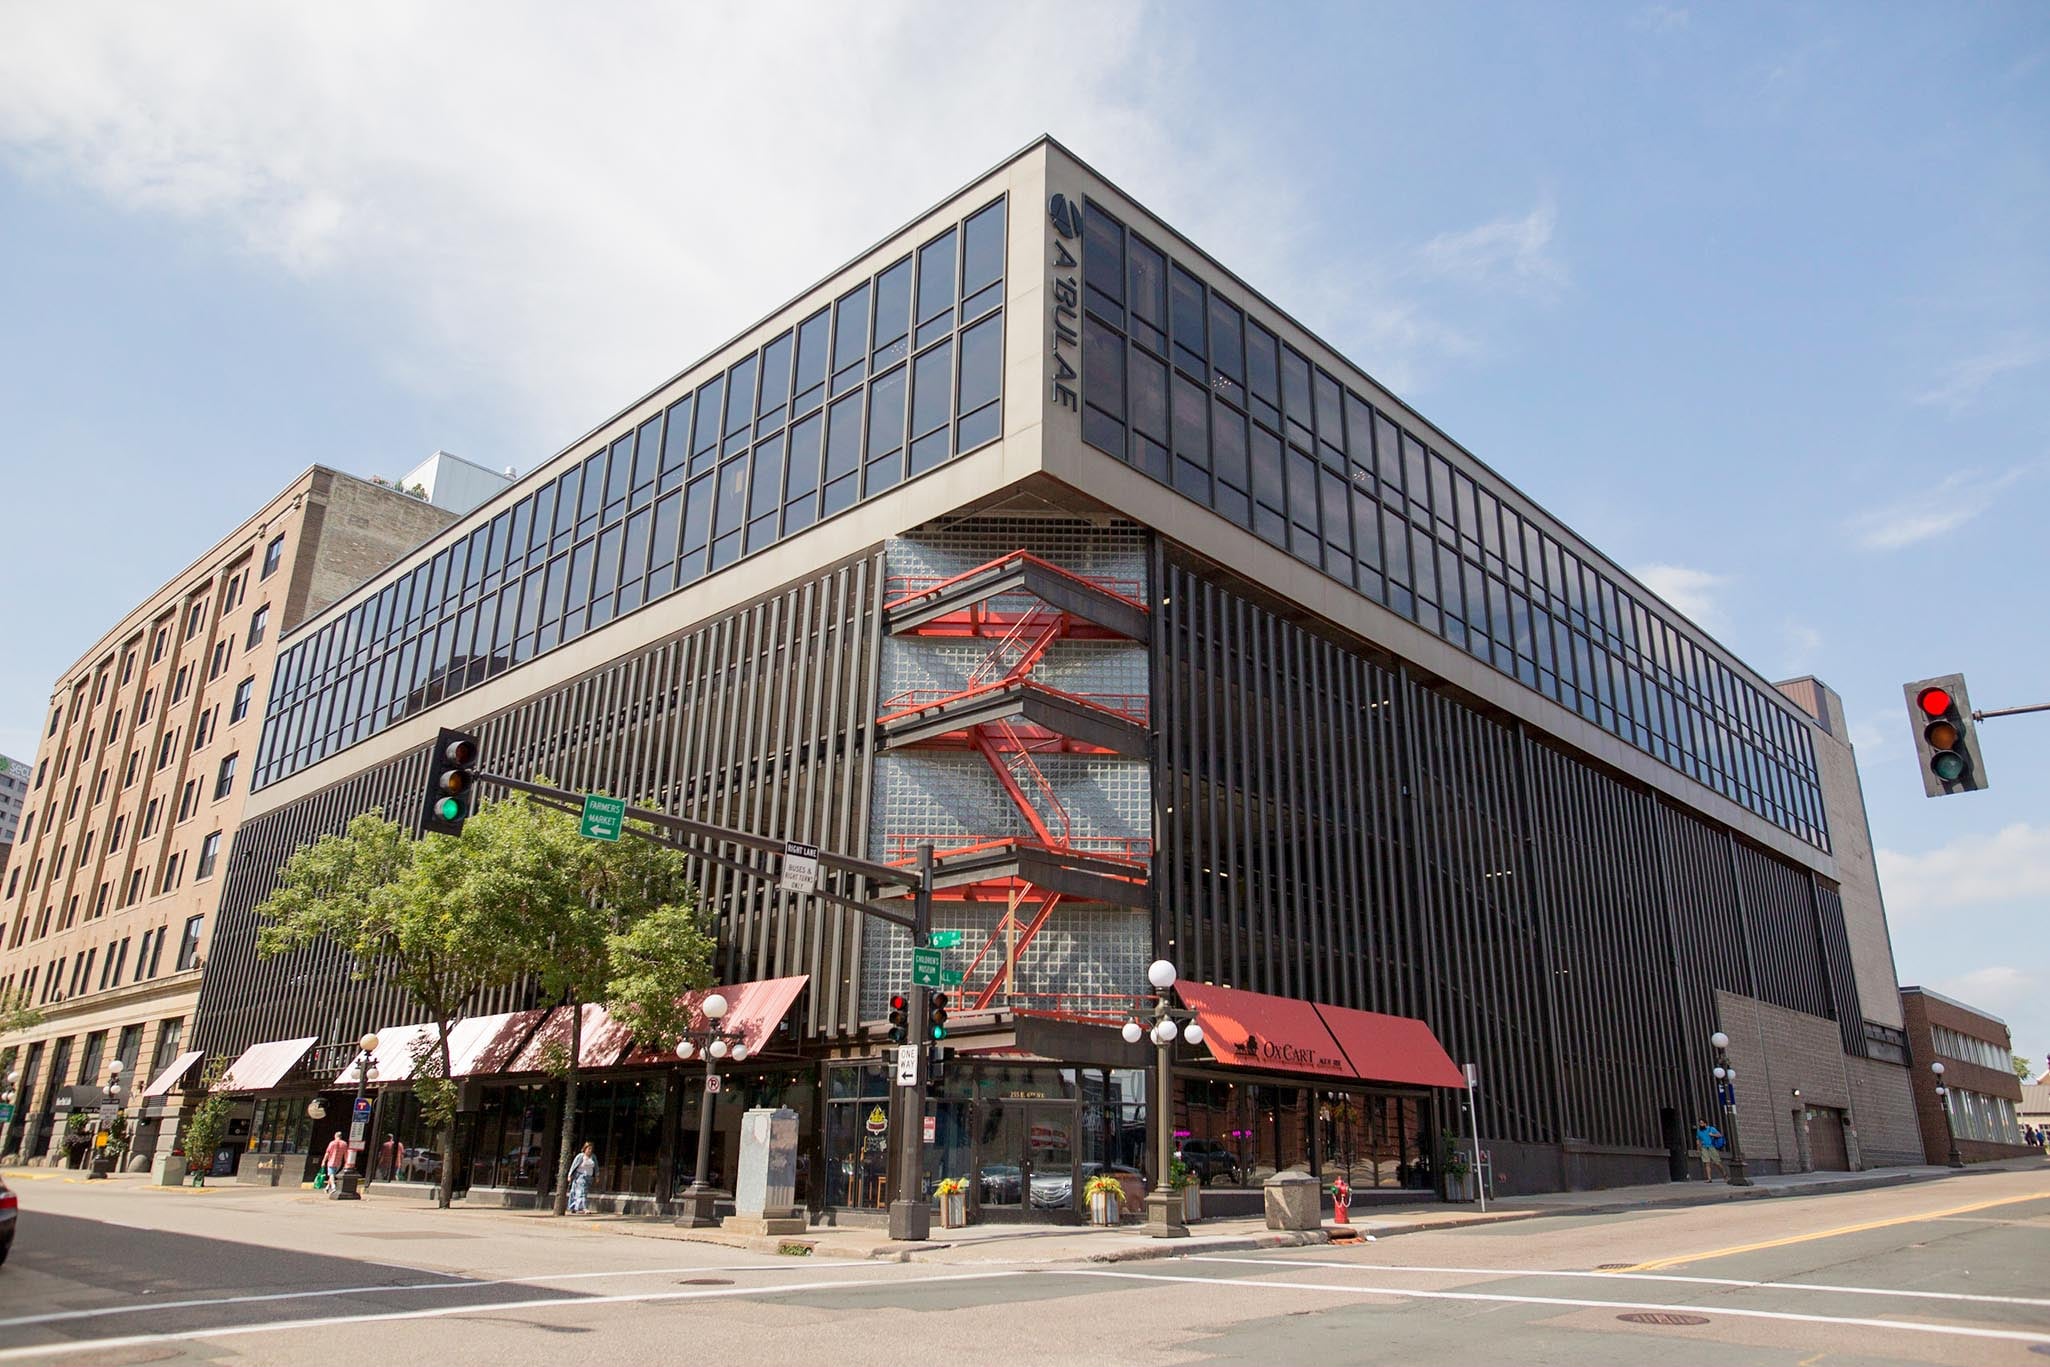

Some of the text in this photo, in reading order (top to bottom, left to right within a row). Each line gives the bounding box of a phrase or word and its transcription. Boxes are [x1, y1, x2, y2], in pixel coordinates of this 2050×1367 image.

[589, 801, 621, 814] FARMERS
[588, 814, 617, 826] MARKET
[787, 843, 818, 858] RIGHT LANE
[901, 1049, 915, 1059] ONE
[900, 1060, 915, 1069] WAY
